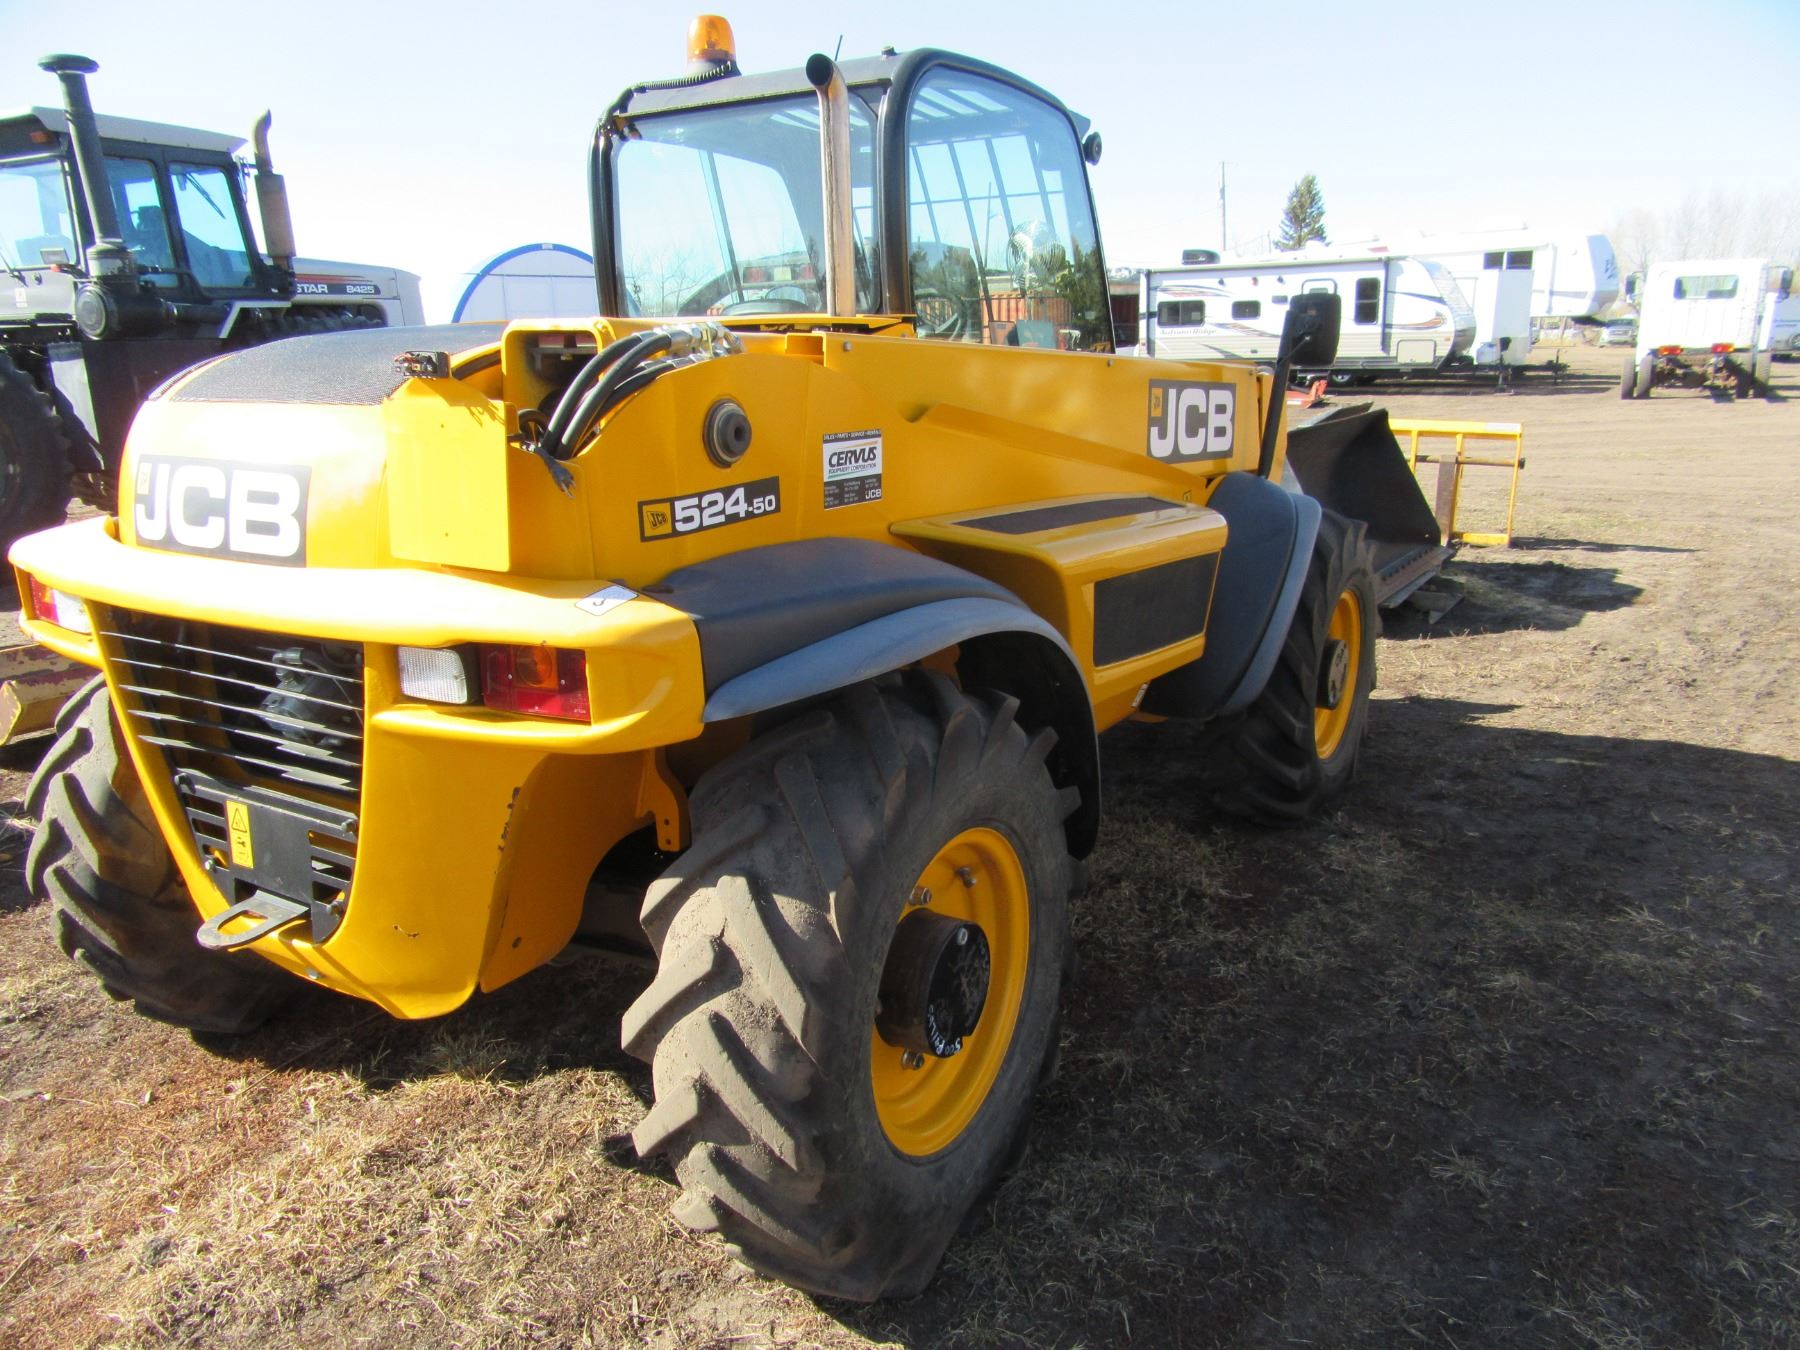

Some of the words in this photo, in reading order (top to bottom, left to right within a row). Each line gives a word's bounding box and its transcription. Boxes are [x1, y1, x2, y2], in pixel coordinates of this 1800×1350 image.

[346, 285, 375, 294] 8425
[1149, 387, 1234, 458] JCB
[828, 446, 877, 468] CERVUS
[865, 488, 882, 500] JCB
[135, 463, 300, 558] JCB
[649, 511, 668, 529] JCB
